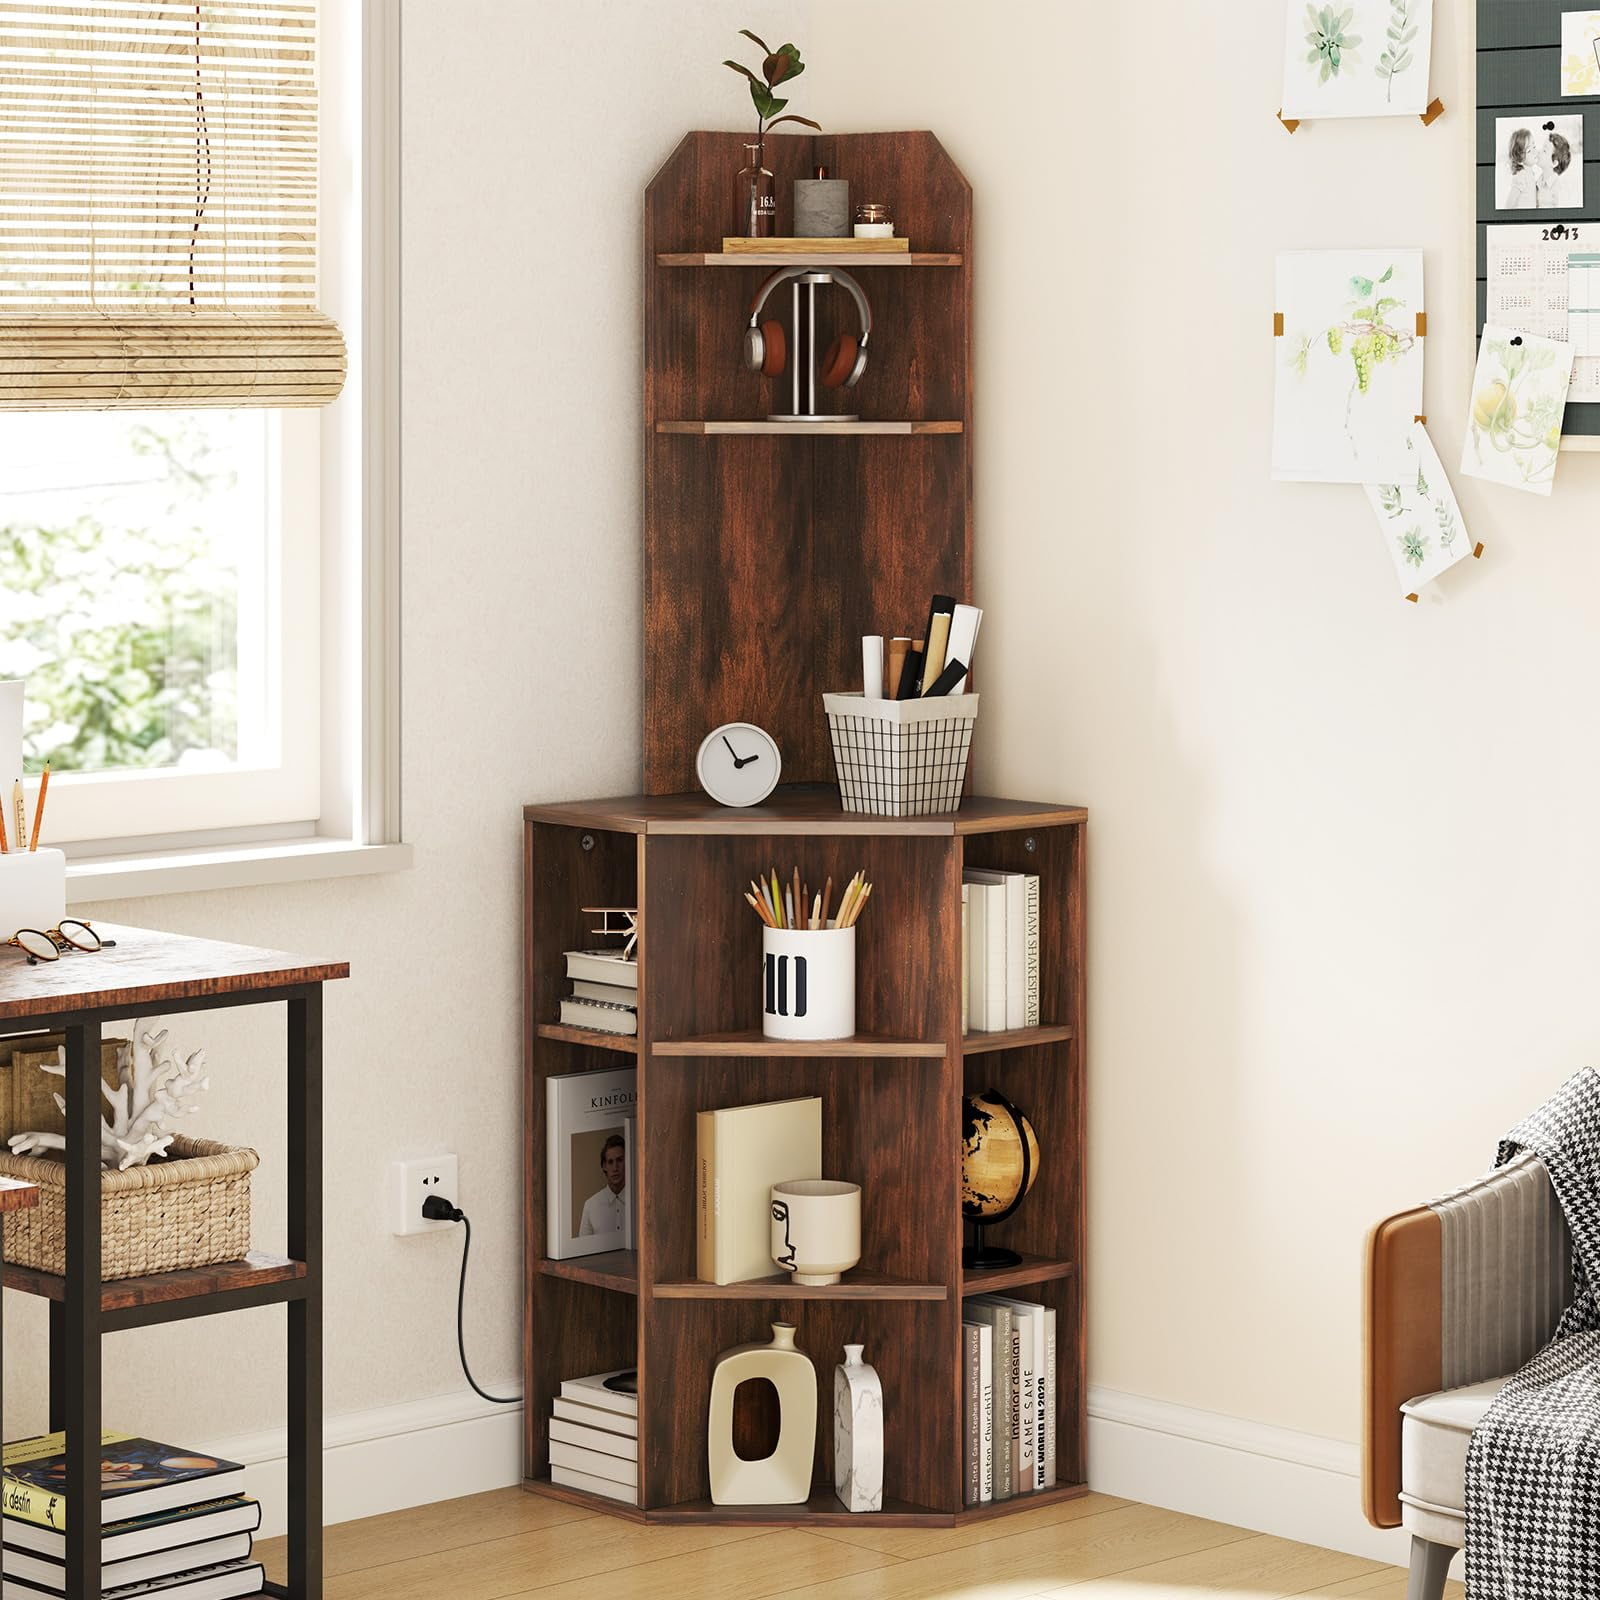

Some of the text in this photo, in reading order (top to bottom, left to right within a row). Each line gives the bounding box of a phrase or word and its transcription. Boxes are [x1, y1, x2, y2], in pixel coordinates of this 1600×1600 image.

[1542, 225, 1579, 241] 2013
[1027, 879, 1038, 1026] WILLIAM SHAKESPEARE
[591, 1091, 638, 1108] KINFOL
[1047, 1334, 1055, 1461] HOUSEHOLD DECORATES
[1024, 1369, 1033, 1458] SAME SAME
[1038, 1409, 1045, 1420] IN
[1004, 1463, 1010, 1473] to
